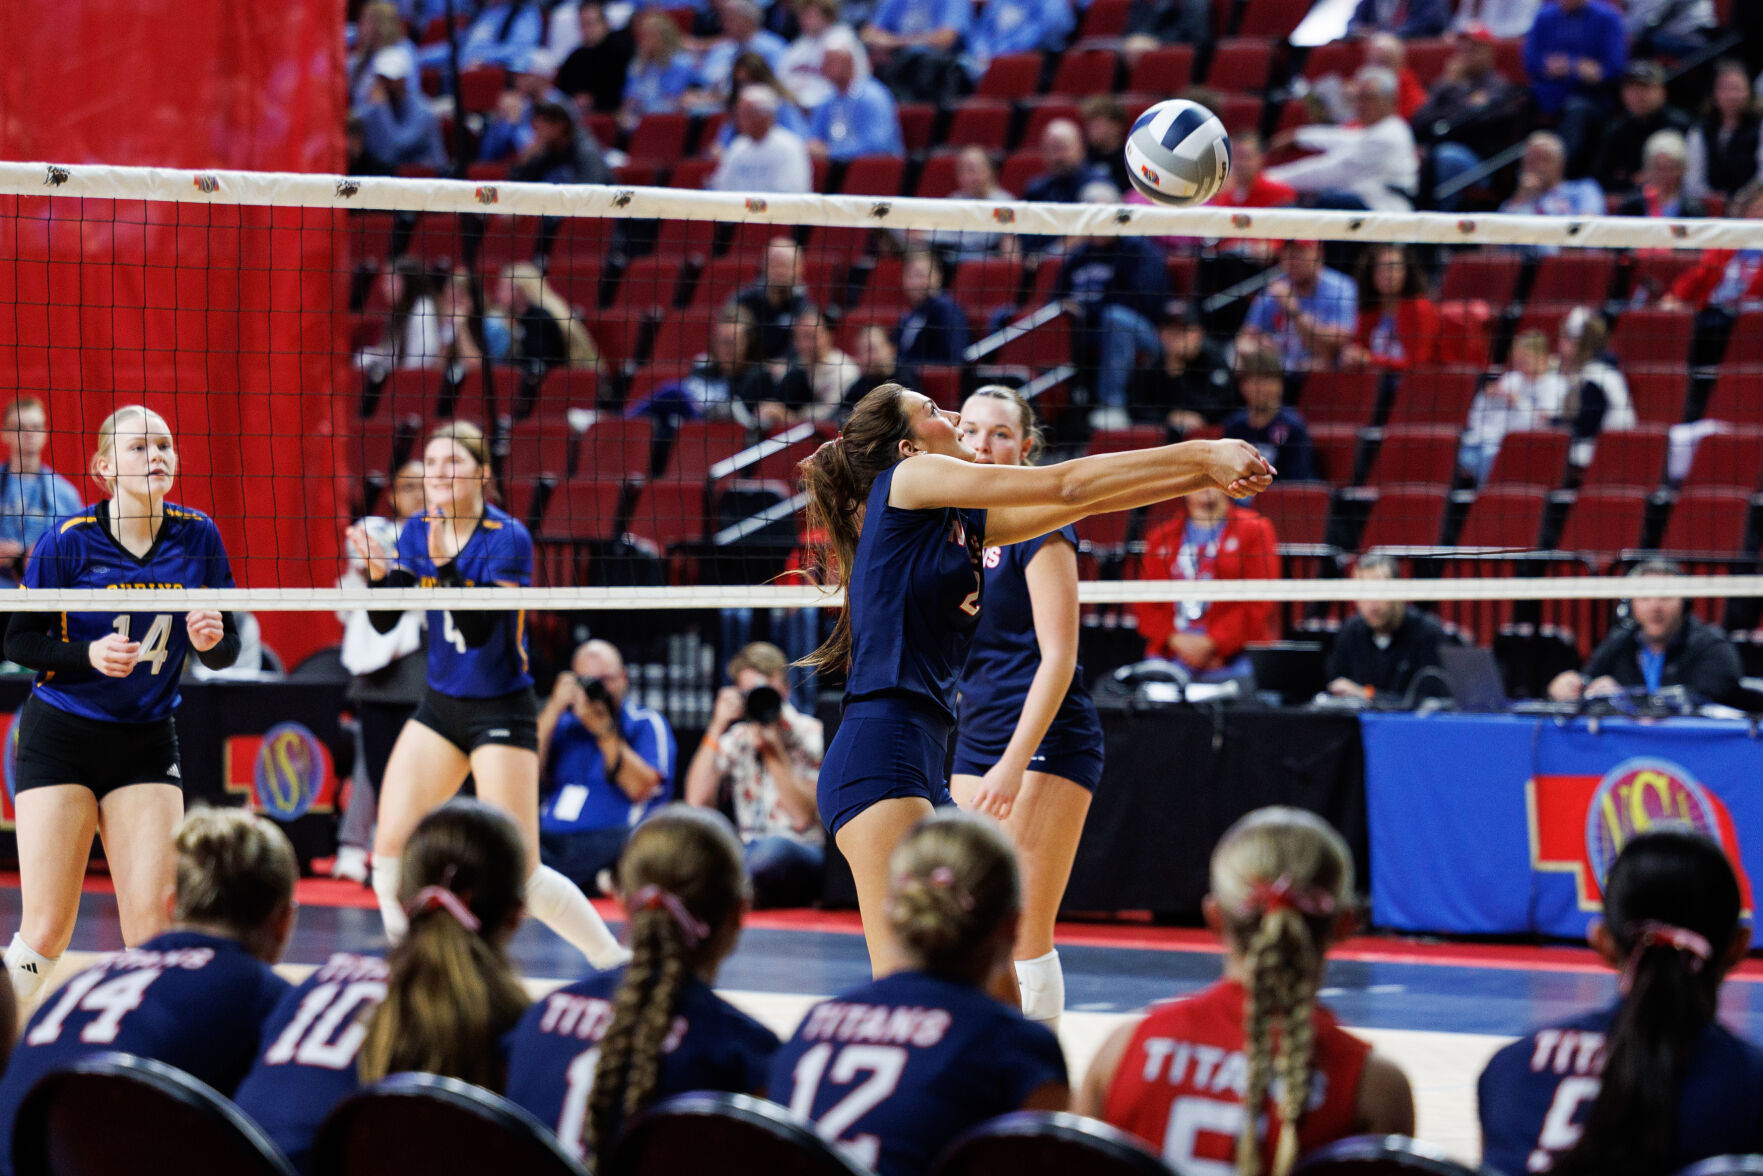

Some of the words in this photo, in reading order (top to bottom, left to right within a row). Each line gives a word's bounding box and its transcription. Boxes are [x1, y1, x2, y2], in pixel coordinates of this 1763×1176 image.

[27, 966, 162, 1046] 14
[265, 981, 390, 1070] 10
[802, 1002, 953, 1048] TITANS
[788, 1042, 909, 1171] 12
[1143, 1037, 1328, 1112] TITAS
